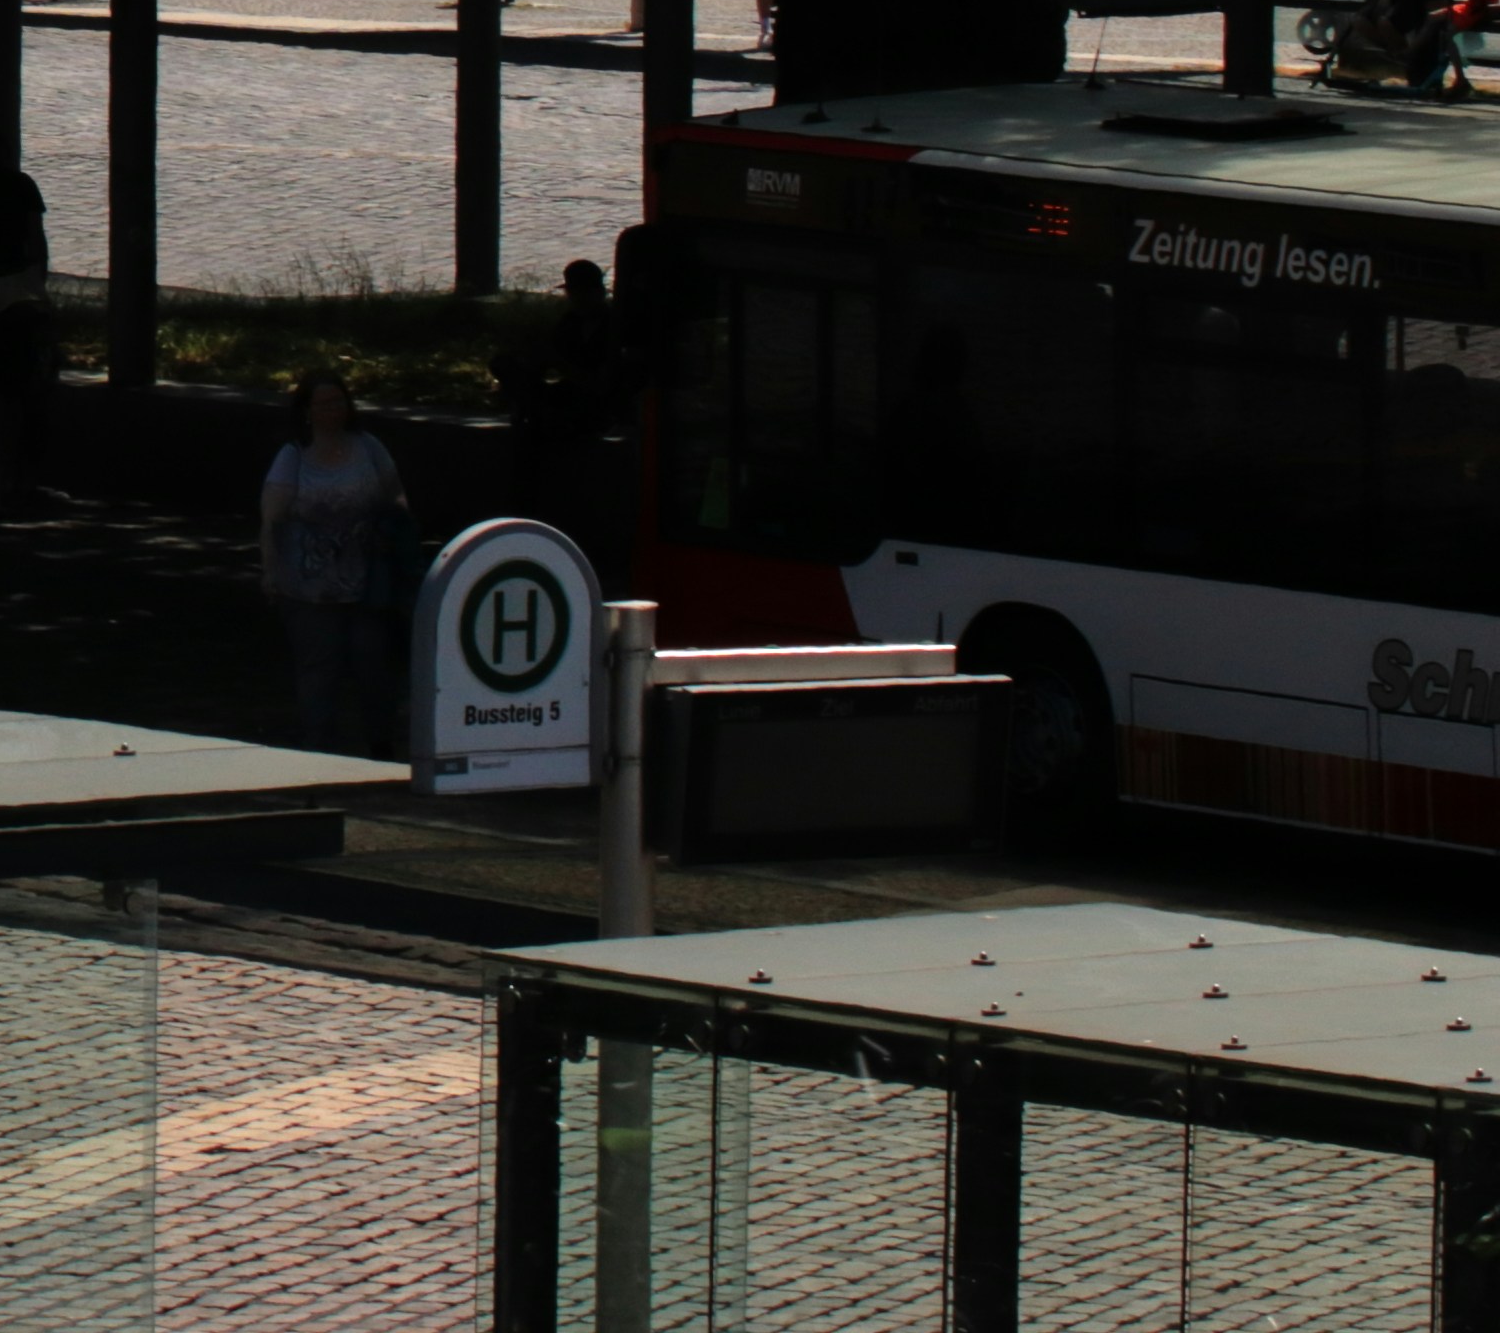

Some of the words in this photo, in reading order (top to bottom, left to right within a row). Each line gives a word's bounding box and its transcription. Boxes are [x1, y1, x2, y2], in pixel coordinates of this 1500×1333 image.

[763, 169, 801, 196] RVM
[1128, 218, 1265, 288] Zeitung
[1274, 232, 1382, 290] lesen.
[492, 589, 538, 664] H
[464, 702, 544, 727] Bussteig
[549, 701, 561, 721] 5
[820, 697, 854, 718] Ziel
[913, 694, 980, 714] Abfahrt
